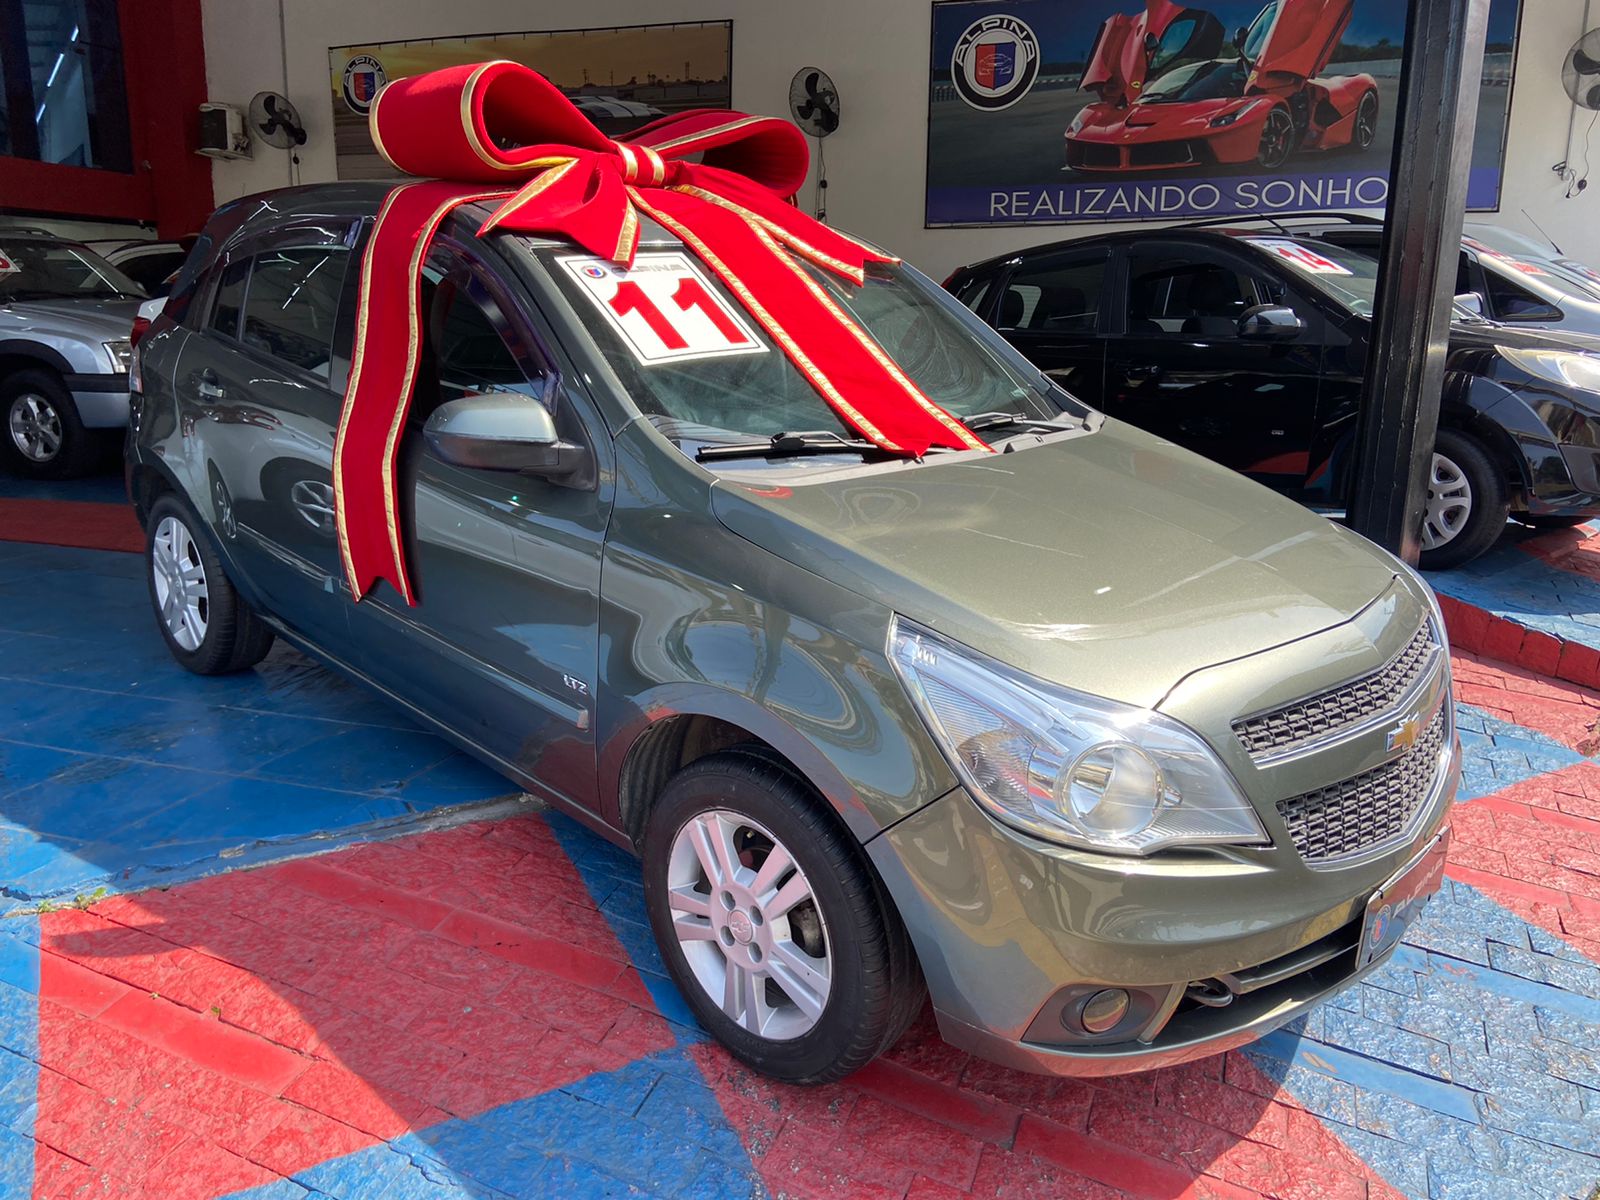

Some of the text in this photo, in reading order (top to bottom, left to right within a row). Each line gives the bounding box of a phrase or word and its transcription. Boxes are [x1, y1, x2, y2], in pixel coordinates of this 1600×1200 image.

[956, 18, 1036, 67] ALPINA
[990, 184, 1220, 217] REALIZANDO
[608, 278, 749, 349] 11
[563, 674, 588, 696] LTZ
